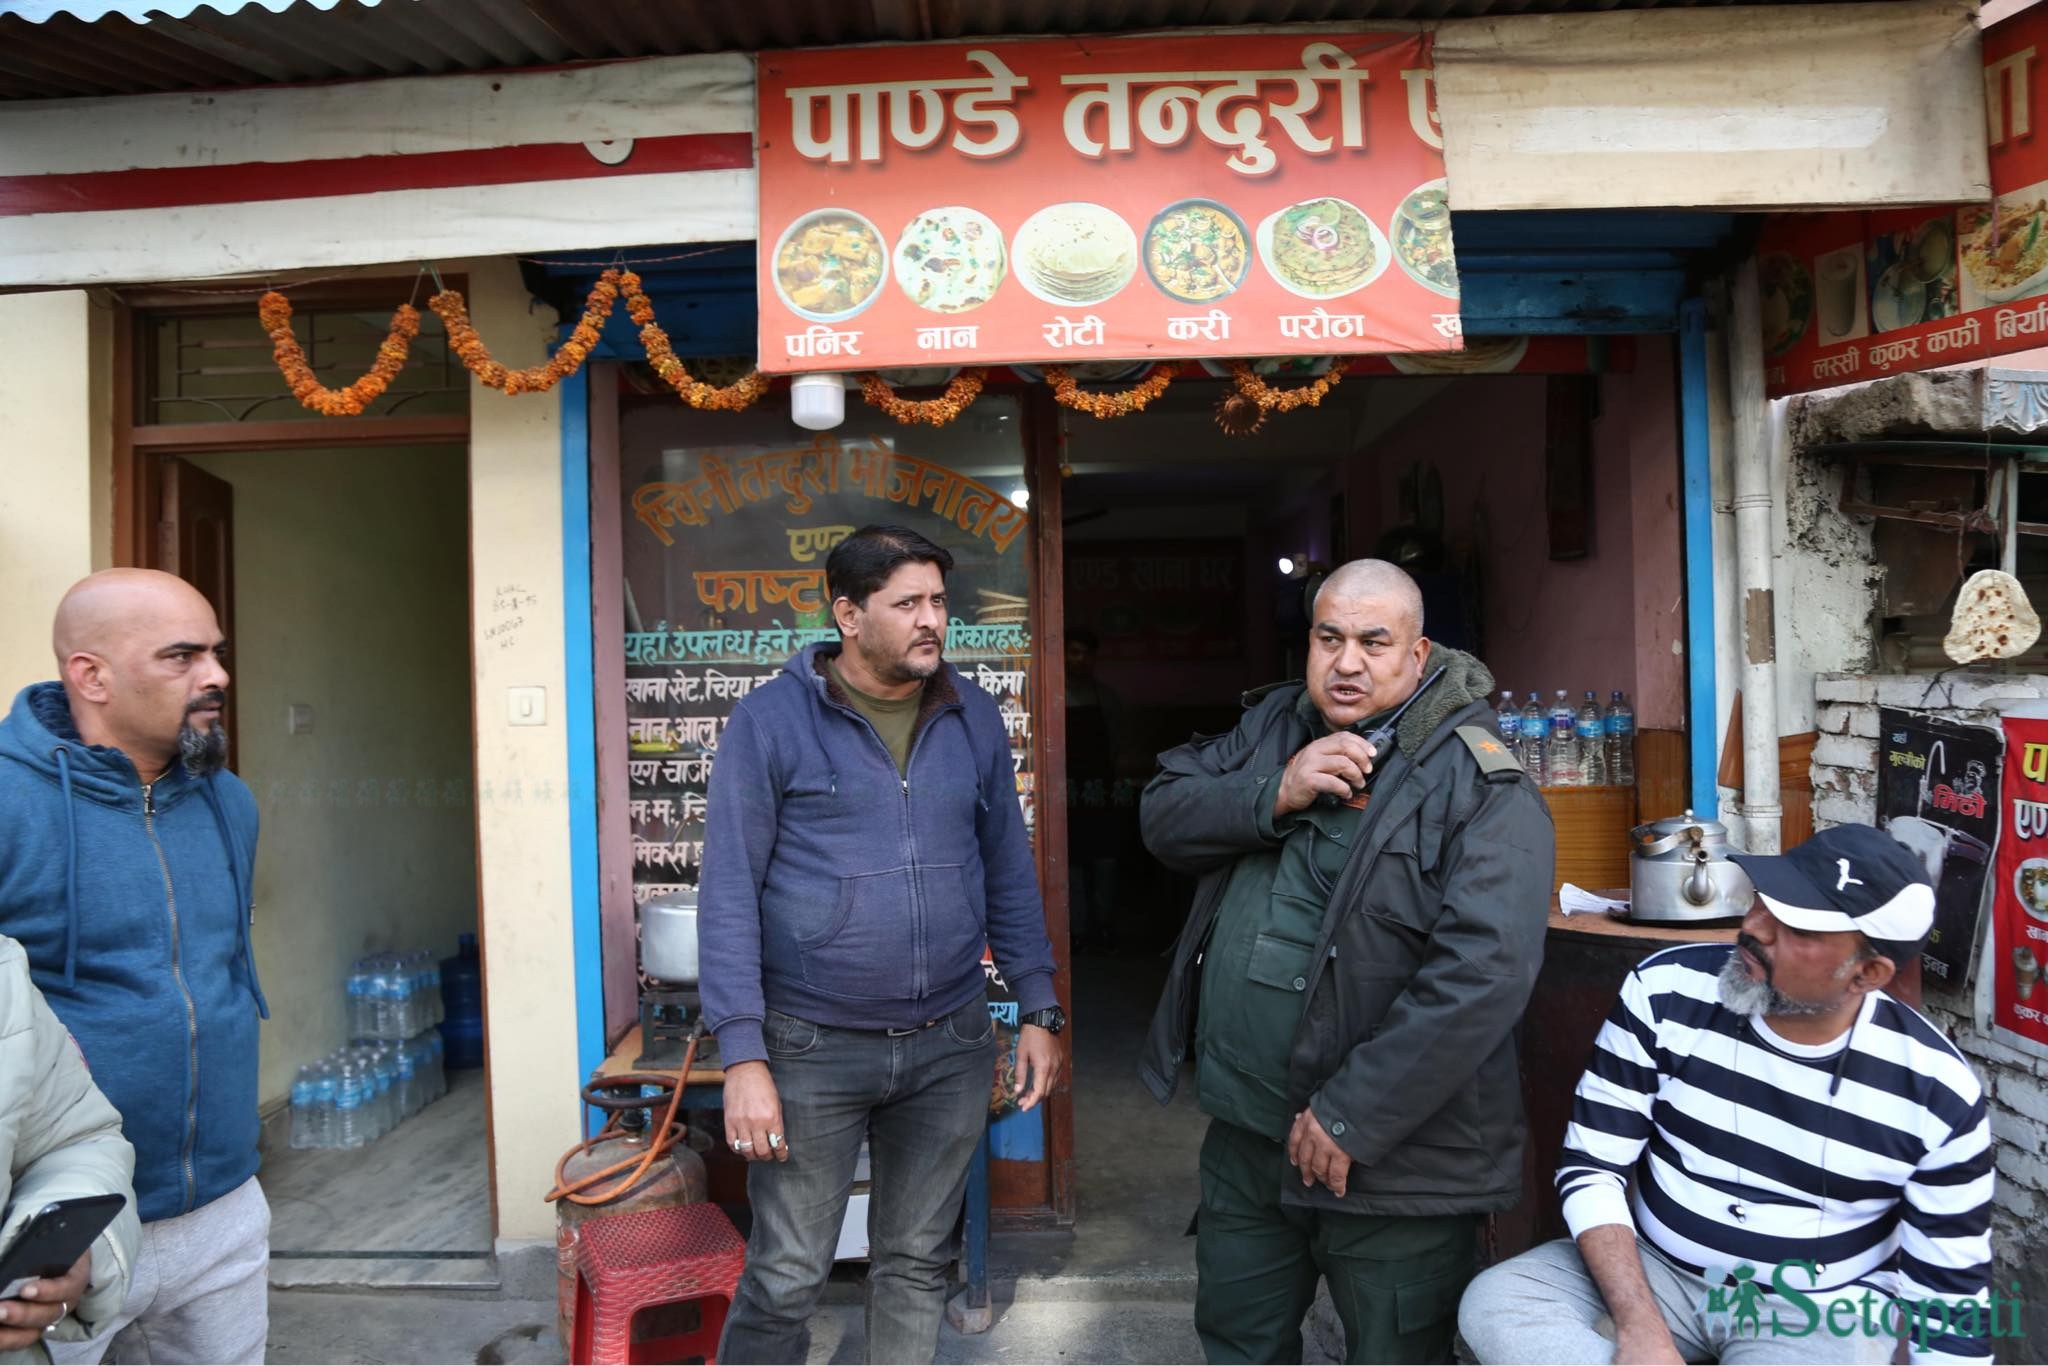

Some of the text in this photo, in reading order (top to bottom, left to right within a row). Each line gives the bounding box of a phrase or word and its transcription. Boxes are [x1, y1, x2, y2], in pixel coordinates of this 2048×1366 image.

[785, 42, 1445, 175] पाण्डे तन्दुरी ए
[785, 325, 864, 358] पनिर
[916, 325, 980, 350] नान
[1042, 314, 1106, 348] रोटी
[1168, 309, 1232, 342] करी
[1278, 307, 1365, 339] परौठा
[1813, 347, 1861, 379] लस्सी
[1869, 336, 1922, 370] कुकर
[1926, 317, 1981, 352] कफी
[1995, 301, 2048, 340] बिर्या
[850, 433, 1030, 553] भोजनालय
[976, 663, 1026, 696] किमा
